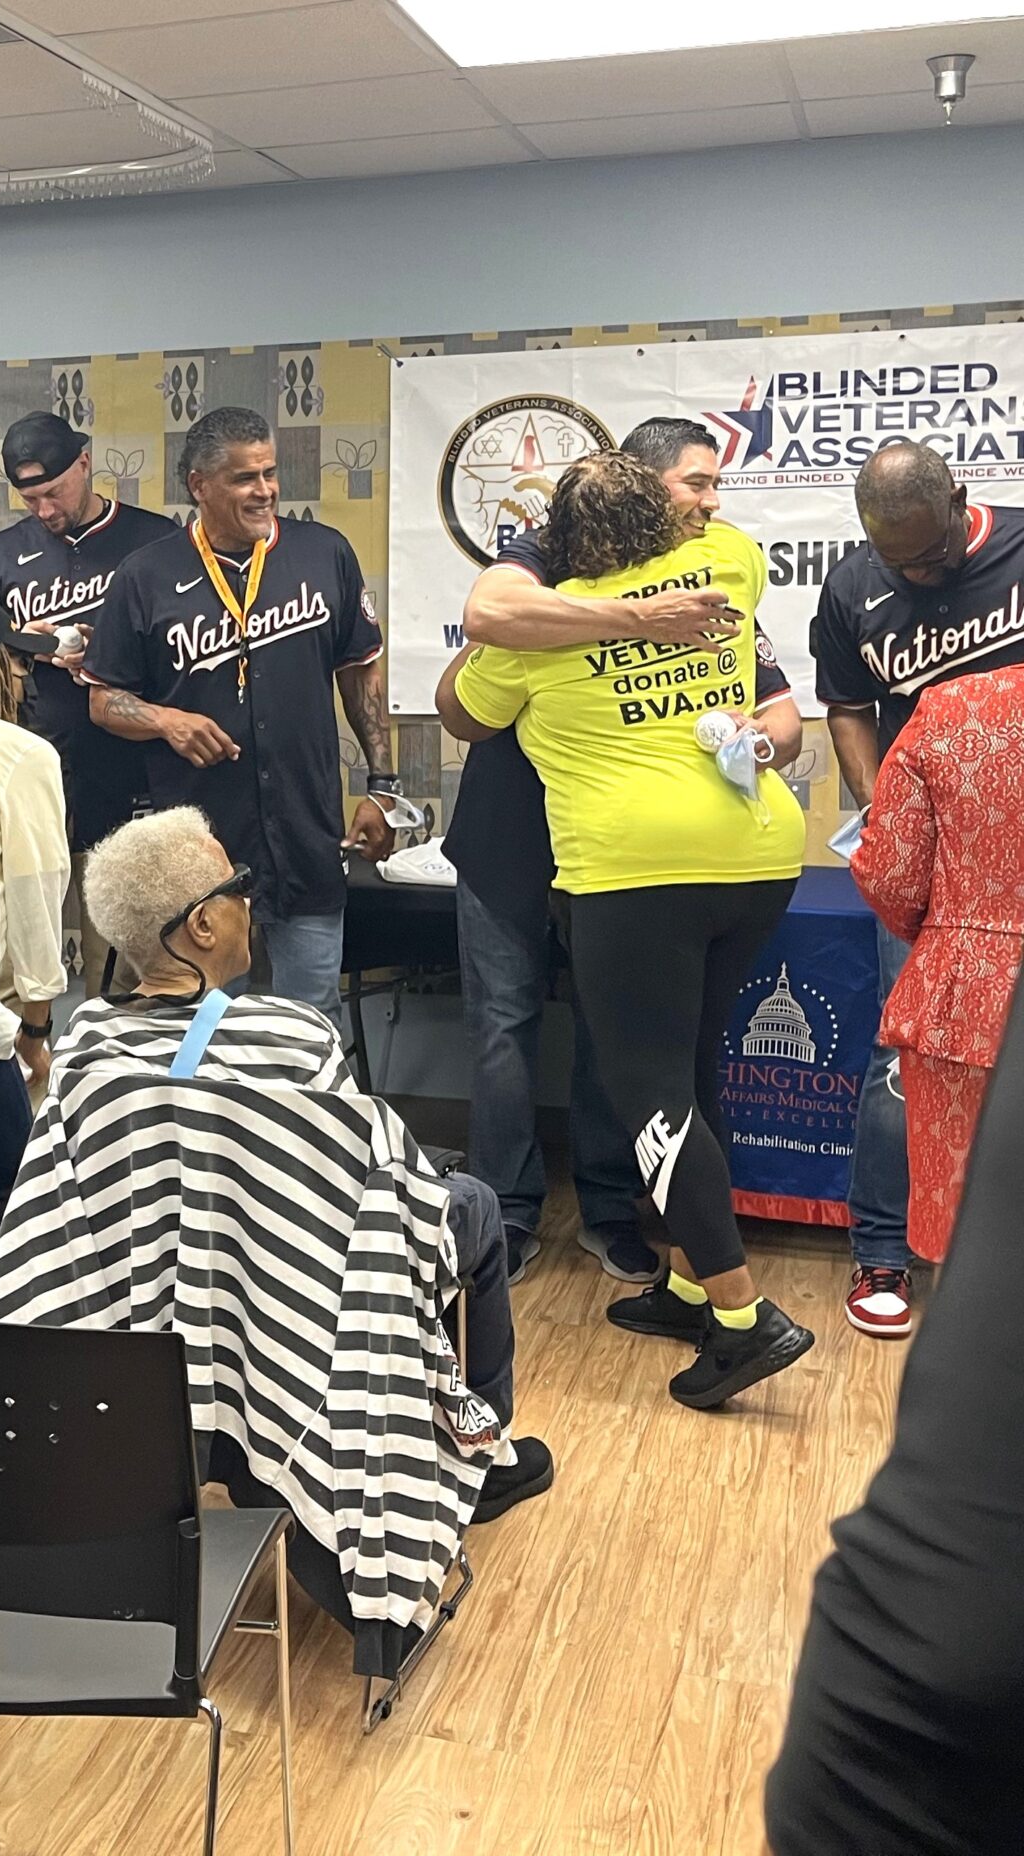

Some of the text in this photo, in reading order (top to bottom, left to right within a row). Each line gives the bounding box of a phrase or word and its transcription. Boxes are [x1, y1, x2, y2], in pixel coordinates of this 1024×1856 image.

[778, 363, 998, 401] BLINDED
[448, 399, 611, 464] BLINDED VETERANS ASSOCIATIO
[719, 475, 768, 486] RVING
[774, 473, 844, 484] BLINDED
[861, 581, 1024, 683] National
[613, 647, 738, 695] donate @
[619, 680, 745, 726] BVA.org
[718, 1062, 858, 1097] HINGTON
[635, 1109, 678, 1187] NIKE
[732, 1131, 816, 1154] Rehabilitation
